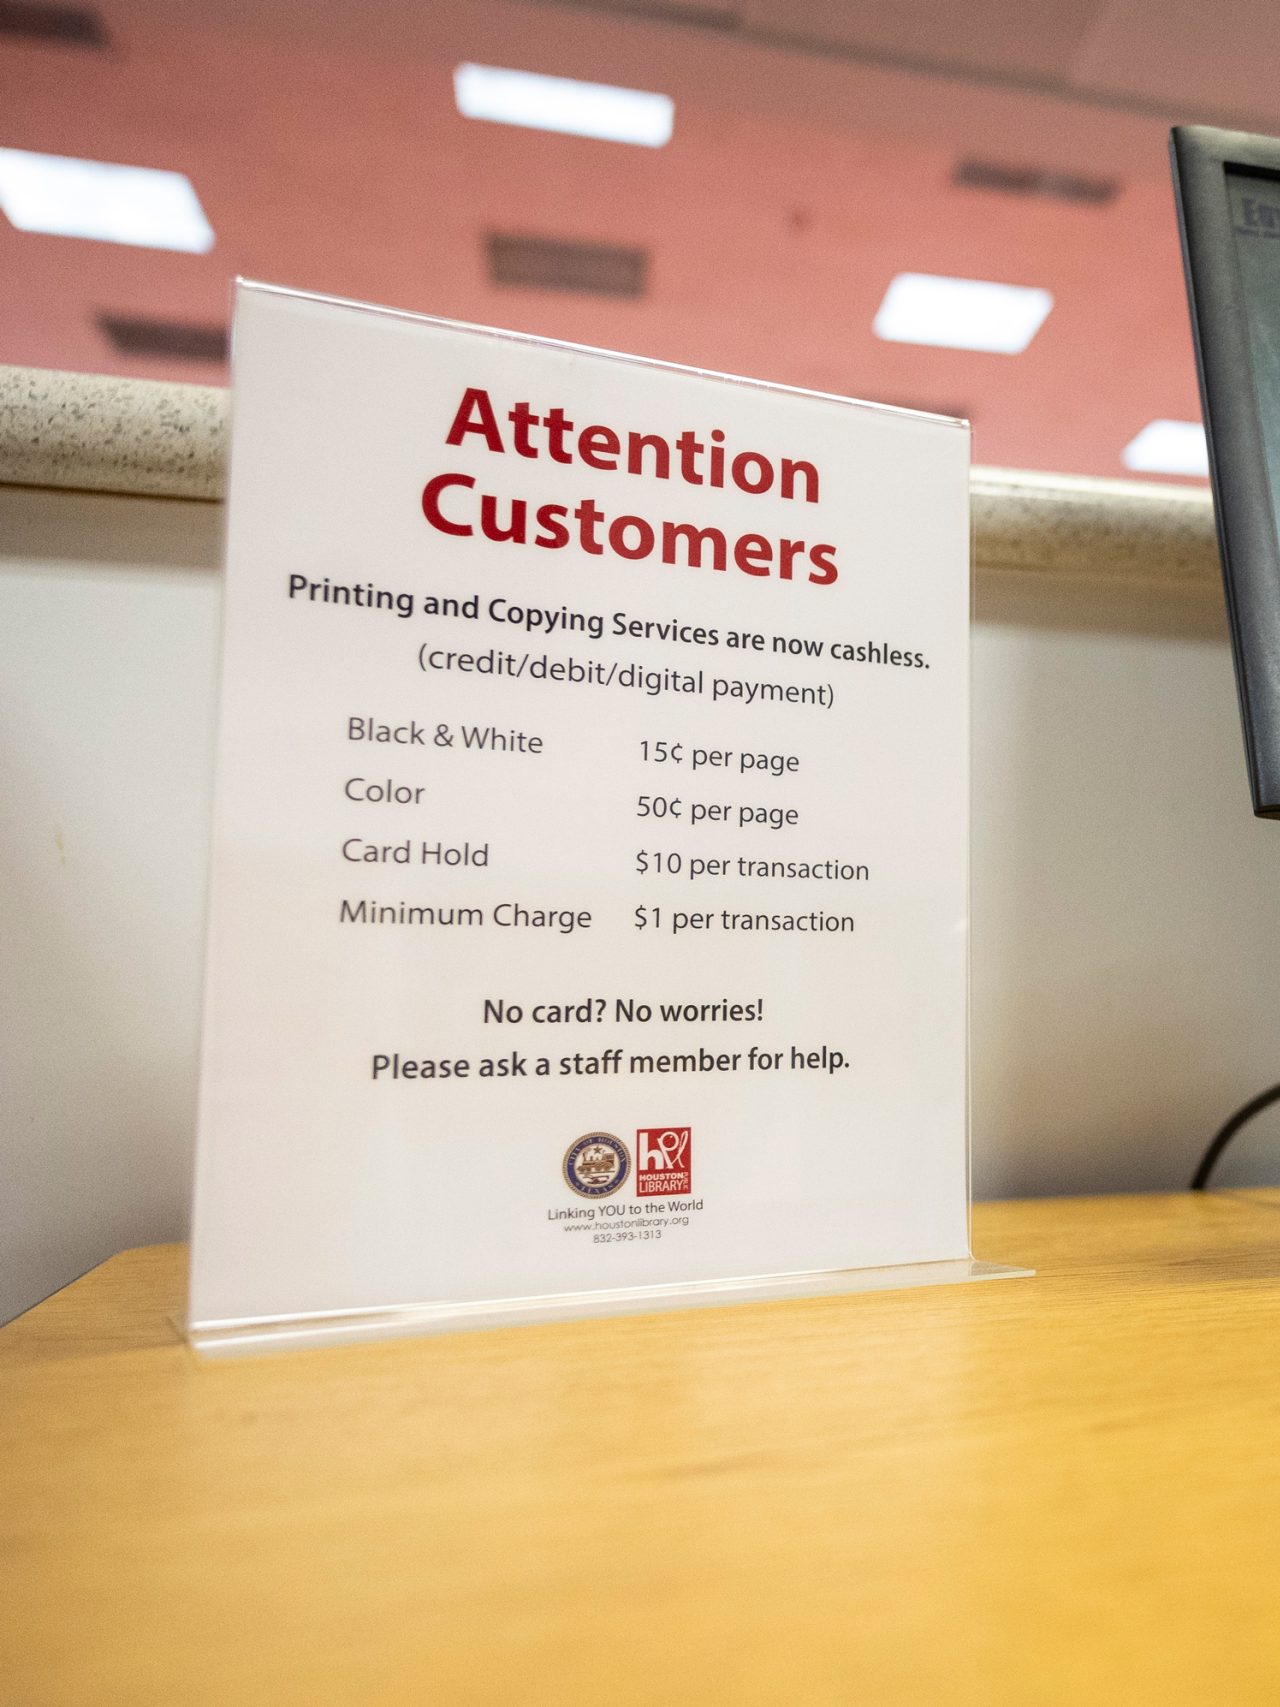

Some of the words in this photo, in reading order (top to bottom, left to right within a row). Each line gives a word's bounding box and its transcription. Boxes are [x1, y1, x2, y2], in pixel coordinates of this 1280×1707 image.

[445, 387, 821, 504] Attention
[422, 472, 839, 586] Customers
[289, 574, 414, 618] Printing
[424, 595, 479, 619] and
[489, 599, 603, 639] Copying
[612, 613, 719, 646] Services
[726, 632, 765, 651] are
[773, 637, 824, 657] now
[831, 641, 929, 669] cashless.
[419, 643, 703, 695] (credit/debit/digital
[713, 679, 833, 709] payment)
[348, 717, 425, 745] Black
[434, 724, 454, 747] &
[461, 726, 543, 753] White
[641, 741, 683, 764] 15¢
[693, 749, 733, 770] per
[741, 753, 799, 776] page
[345, 778, 425, 804] Color
[637, 796, 682, 818] 50¢
[692, 804, 732, 825] per
[740, 807, 798, 829] page
[342, 839, 410, 864] Card
[422, 842, 488, 866] Hold
[636, 849, 681, 875] $10
[690, 859, 730, 880] per
[737, 857, 868, 880] transaction
[340, 900, 483, 926] Minimum
[493, 903, 592, 934] Charge
[635, 905, 660, 930] $1
[673, 913, 714, 934] per
[721, 910, 854, 932] transaction
[484, 999, 523, 1023] No
[532, 998, 606, 1023] card?
[616, 999, 652, 1022] No
[660, 999, 763, 1022] worries!
[373, 1053, 470, 1079] Please
[479, 1051, 527, 1077] ask
[535, 1058, 550, 1076] a
[560, 1049, 623, 1075] staff
[630, 1048, 741, 1073] member
[748, 1047, 783, 1070] for
[791, 1046, 849, 1074] help.
[639, 1173, 683, 1181] HOUSTON
[639, 1180, 683, 1193] LIBRARY
[548, 1208, 595, 1221] Linking
[598, 1205, 625, 1216] YOU
[629, 1205, 643, 1215] to
[645, 1202, 665, 1213] the
[668, 1199, 703, 1212] World
[563, 1216, 690, 1232] www.houstonlibrary.org
[593, 1230, 662, 1243] 832-393-1313
